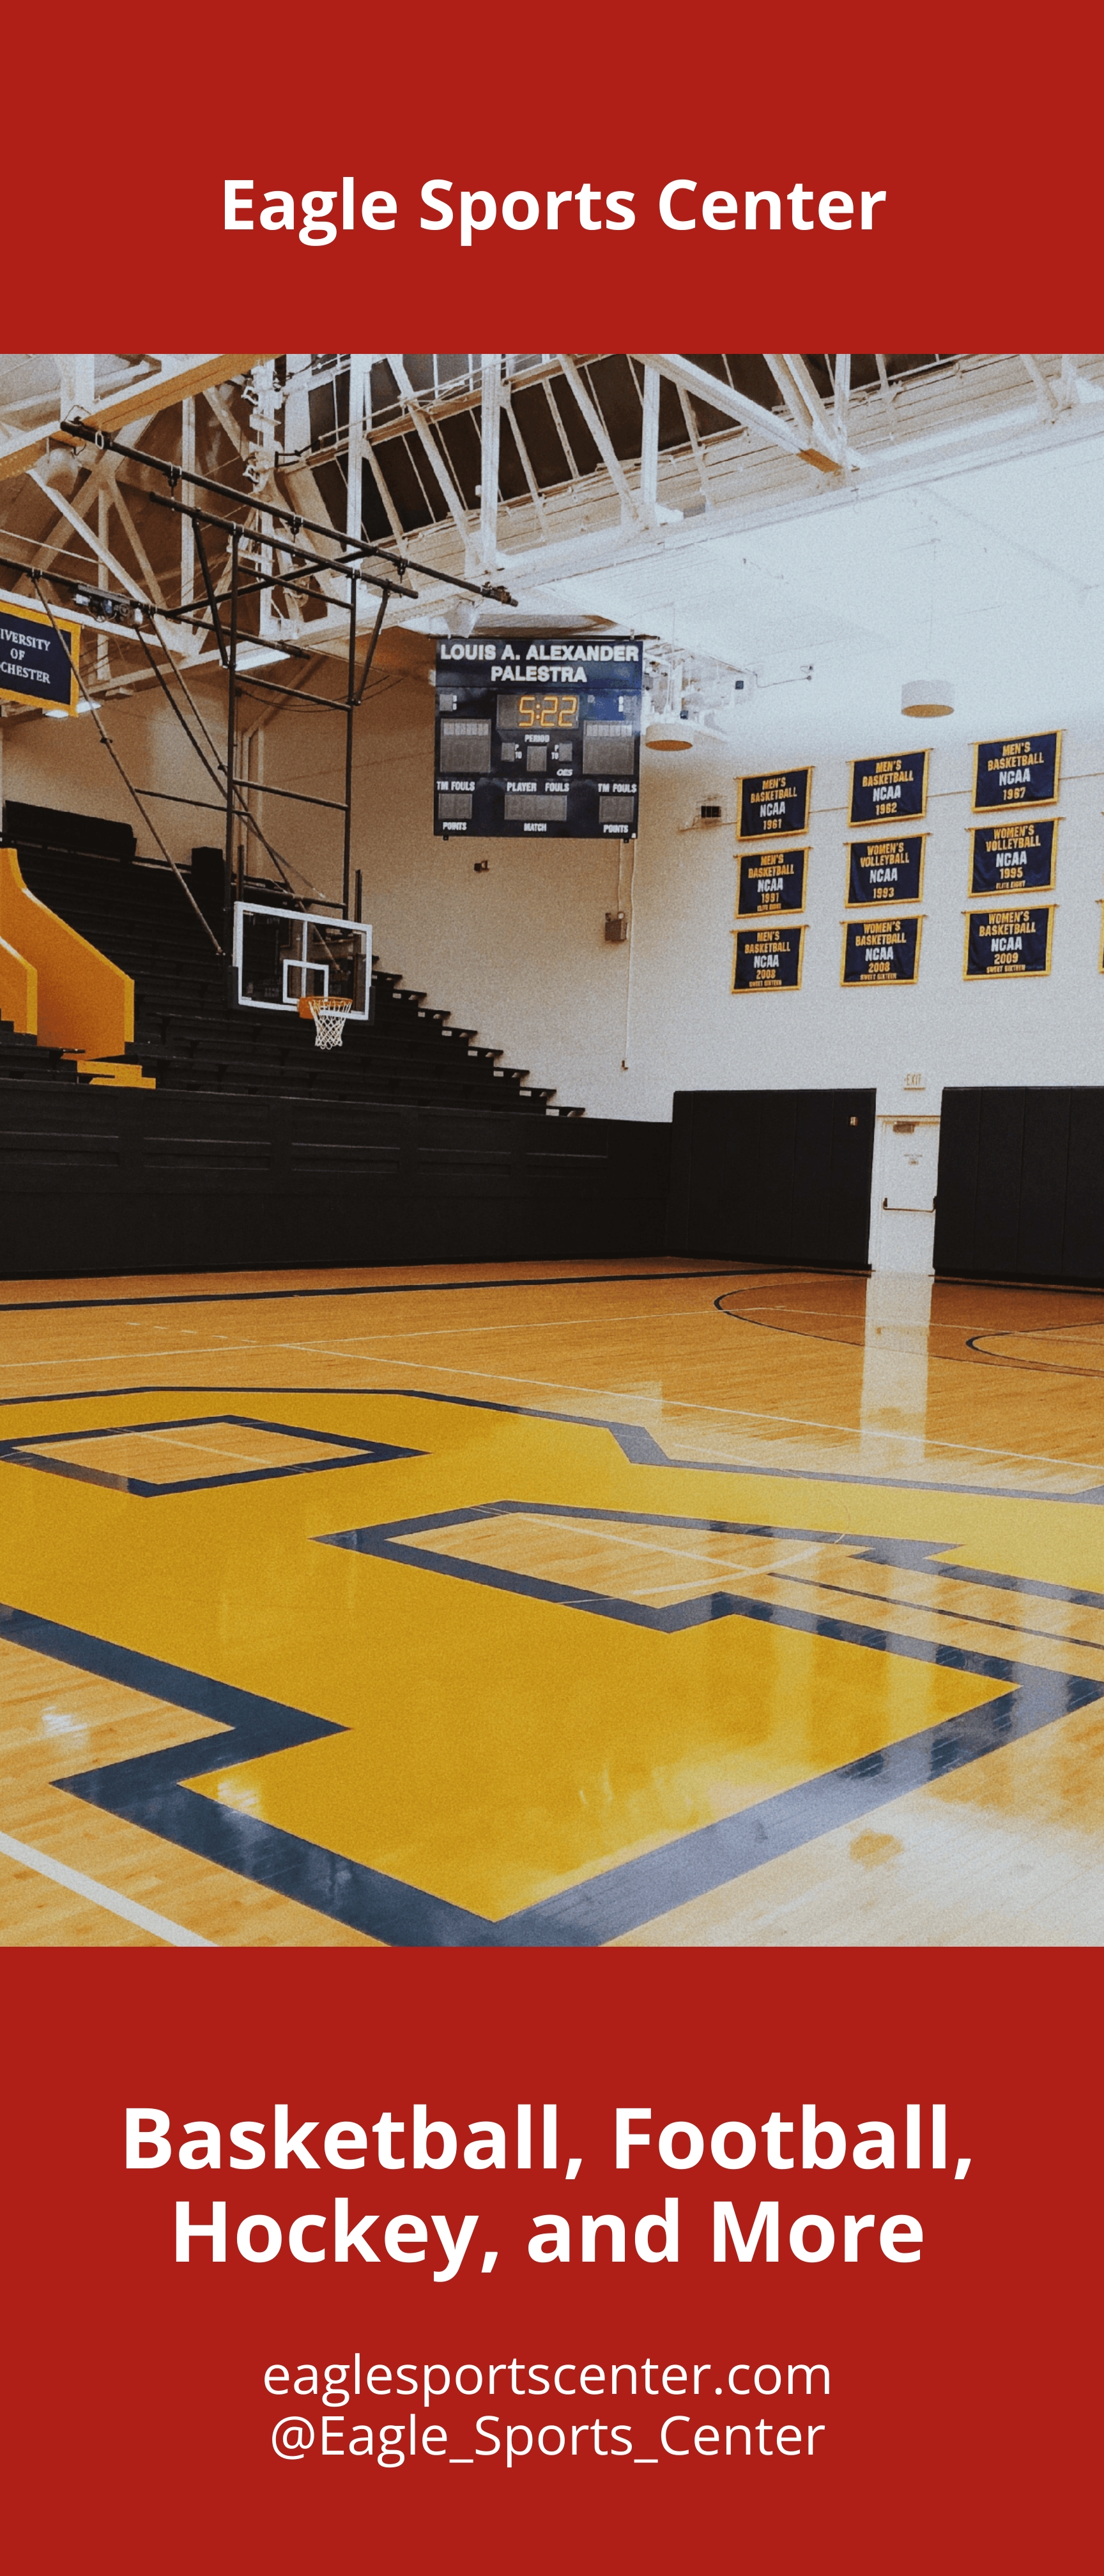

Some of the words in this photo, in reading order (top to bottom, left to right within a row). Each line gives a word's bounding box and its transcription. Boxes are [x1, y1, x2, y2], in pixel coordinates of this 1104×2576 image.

[10, 648, 25, 661] OF
[440, 644, 496, 660] LOUIS
[501, 644, 520, 660] A.
[526, 645, 639, 662] ALEXANDER
[0, 661, 50, 684] CHESTER
[491, 665, 587, 682] PALESTRA
[519, 696, 578, 727] 5:22
[525, 734, 550, 742] PERIOD
[1002, 742, 1031, 756] MEN'S
[876, 760, 901, 774] MEN'S
[988, 752, 1045, 771] BASKETBALL
[762, 777, 786, 790] MEN'S
[862, 770, 914, 787] BASKETBALL
[999, 768, 1031, 786] NCAA
[436, 781, 448, 790] TM
[451, 781, 475, 791] FOULS
[507, 782, 537, 792] PLAYER
[545, 783, 569, 792] FOULS
[598, 783, 610, 792] TM
[613, 783, 637, 793] FOULS
[750, 786, 797, 803] BASKETBALL
[873, 785, 901, 802] NCAA
[1003, 787, 1026, 801] 1967
[760, 801, 786, 818] NCAA
[876, 802, 897, 816] 1962
[443, 822, 467, 830] POINTS
[524, 823, 547, 831] MATCH
[603, 825, 628, 833] POINTS
[763, 818, 782, 831] 1961
[993, 825, 1034, 839] WOMEN'S
[867, 842, 904, 855] WOMEN'S
[986, 835, 1041, 852] VOLLEYBALL
[761, 854, 784, 866] MEN'S
[860, 852, 909, 868] VOLLEYBALL
[996, 850, 1027, 868] NCAA
[748, 864, 794, 878] BASKETBALL
[870, 868, 898, 884] NCAA
[1000, 867, 1023, 879] 1995
[757, 878, 783, 893] NCAA
[873, 887, 894, 898] 1993
[762, 893, 779, 903] 1991
[989, 911, 1029, 924] WOMEN'S
[864, 921, 901, 934] WOMEN'S
[979, 922, 1036, 937] BASKETBALL
[757, 931, 779, 942] MEN'S
[855, 932, 907, 946] BASKETBALL
[745, 942, 790, 954] BASKETBALL
[991, 937, 1022, 952] NCAA
[865, 946, 894, 962] NCAA
[994, 953, 1018, 965] 2009
[754, 954, 779, 969] NCAA
[906, 1073, 922, 1085] EXIT
